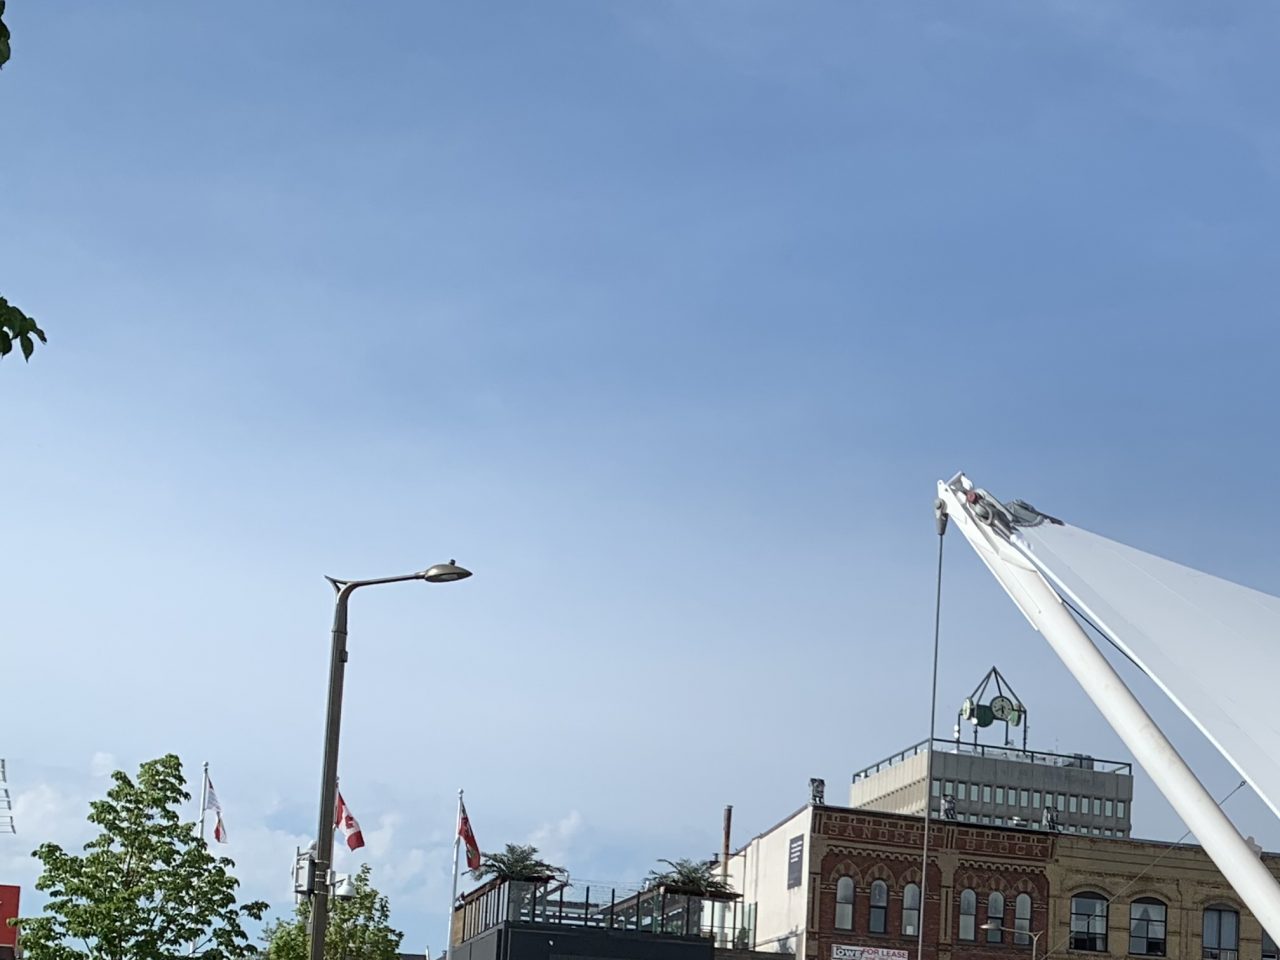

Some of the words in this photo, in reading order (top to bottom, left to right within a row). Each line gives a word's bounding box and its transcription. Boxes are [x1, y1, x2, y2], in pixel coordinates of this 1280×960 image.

[966, 837, 1043, 857] BLOCK
[862, 947, 879, 956] FOR
[881, 949, 908, 959] LEASE
